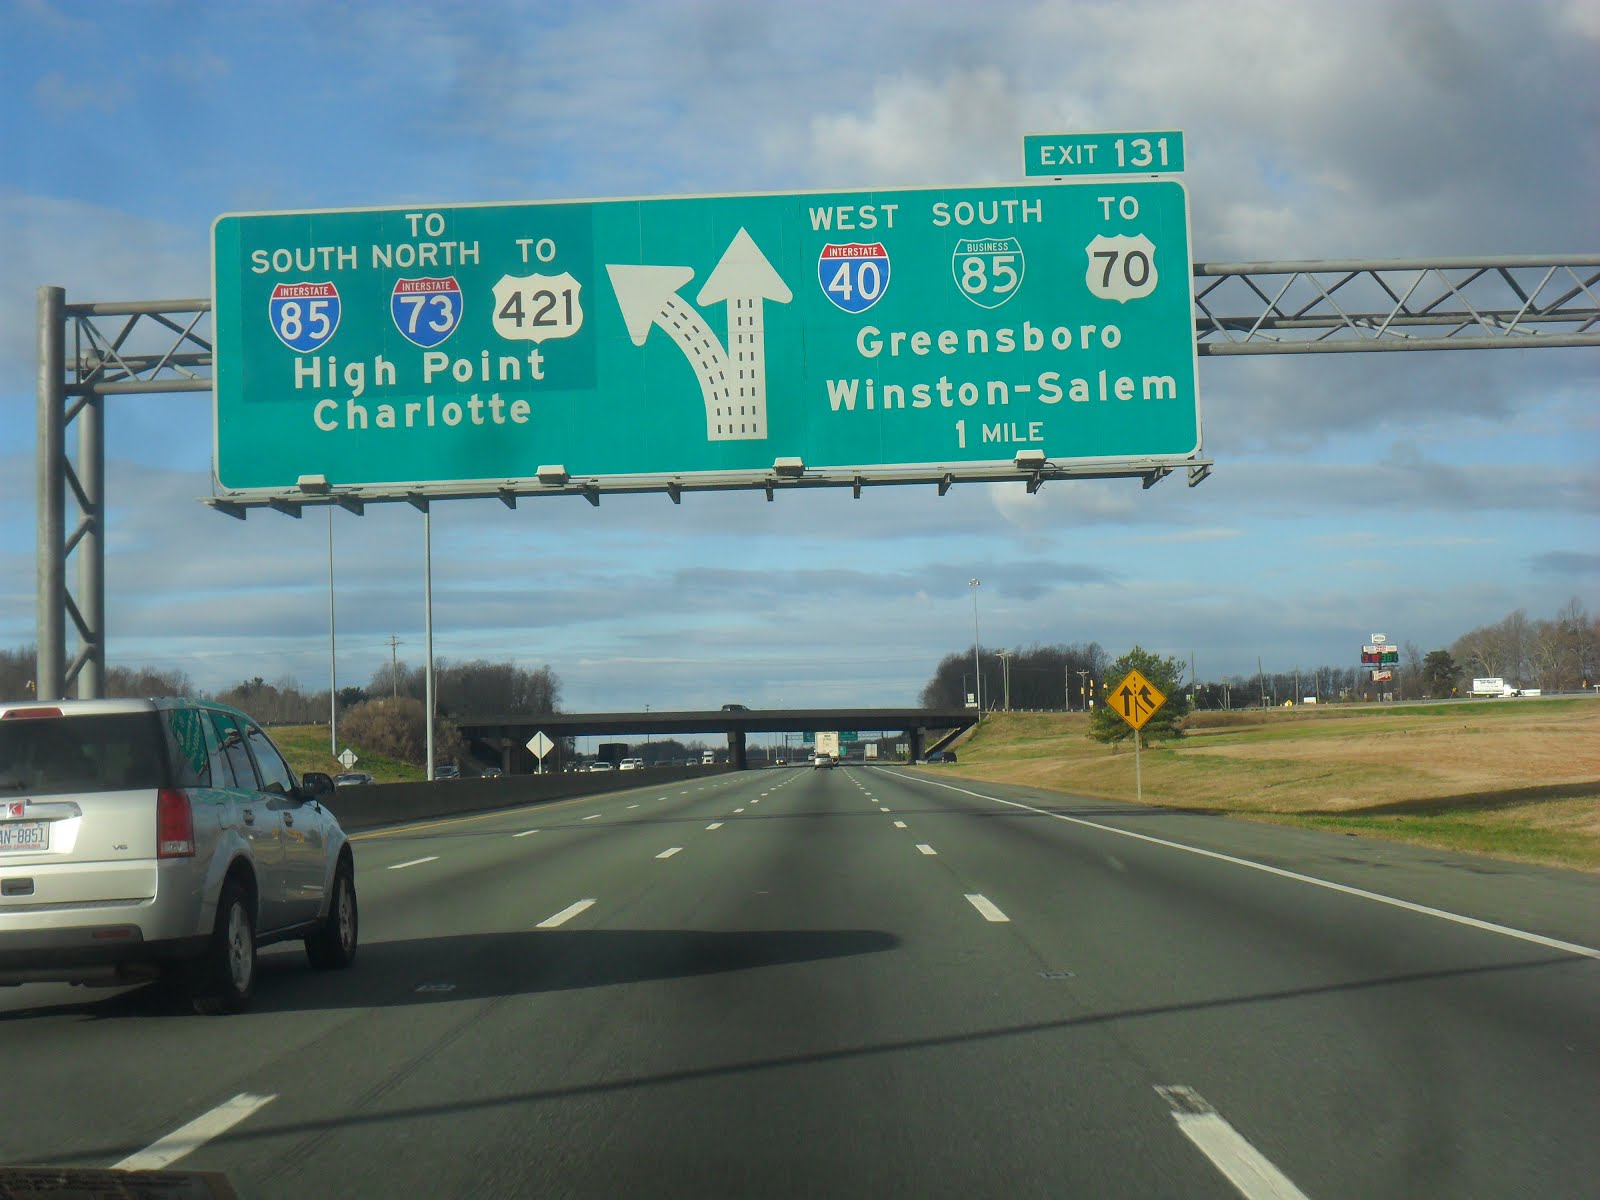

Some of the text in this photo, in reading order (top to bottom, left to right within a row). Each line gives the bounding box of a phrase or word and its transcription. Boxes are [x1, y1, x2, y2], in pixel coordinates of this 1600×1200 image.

[1040, 138, 1169, 167] EXIT 131
[809, 204, 899, 231] WEST
[932, 199, 1042, 227] SOUTH
[1098, 196, 1139, 220] TO
[405, 213, 446, 237] TO
[251, 241, 480, 274] SOUTH NORTH
[515, 238, 556, 263] TO
[829, 246, 878, 257] INTERSTATE
[967, 242, 1009, 252] BUSINESS
[828, 261, 881, 301] 40
[961, 255, 1018, 294] 85
[1093, 250, 1150, 288] 70
[280, 286, 329, 297] INTERSTATE
[402, 281, 451, 292] INTERSTATE
[280, 300, 331, 341] 85
[400, 294, 455, 334] 73
[499, 289, 574, 328] 421
[856, 321, 1122, 358] Greensboro
[294, 348, 545, 398] High Point
[826, 369, 1177, 411] Winston-Salem
[313, 392, 531, 432] Charlotte
[955, 420, 1045, 449] 1 MILE
